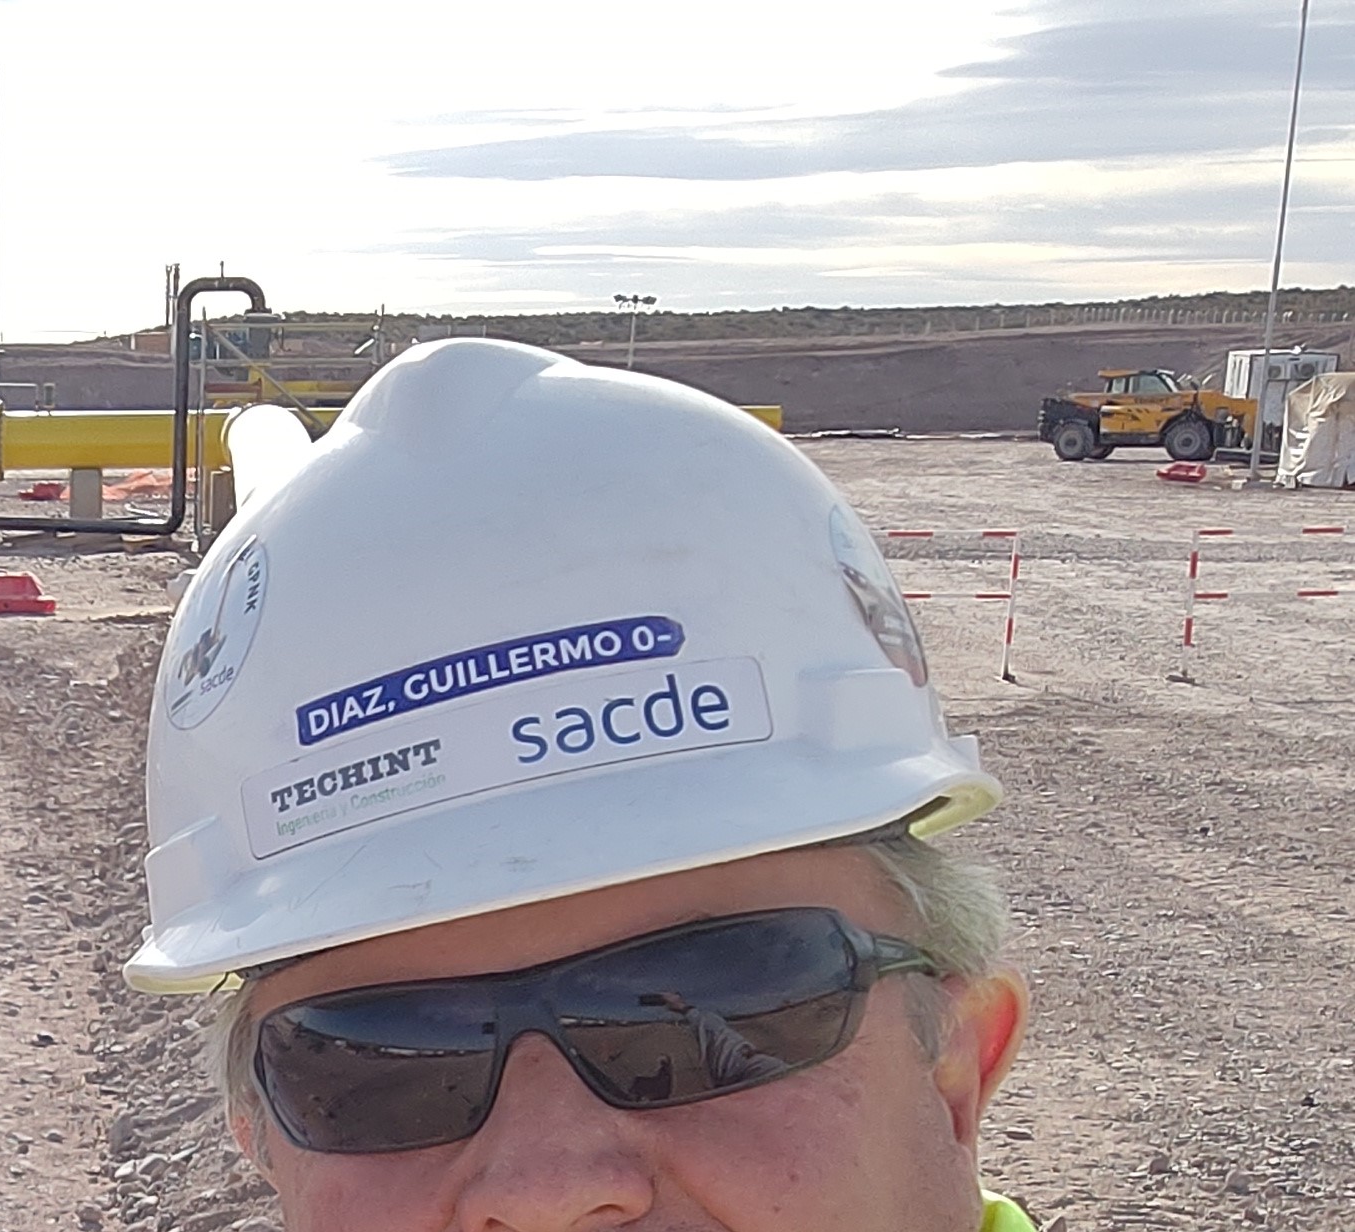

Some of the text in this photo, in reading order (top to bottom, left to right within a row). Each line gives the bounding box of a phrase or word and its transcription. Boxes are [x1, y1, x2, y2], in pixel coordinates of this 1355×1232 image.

[199, 664, 235, 696] sacde
[308, 685, 396, 738] DIAZ,
[403, 629, 623, 702] GUILLERMO
[270, 673, 731, 813] TECHINT sacde
[276, 805, 338, 837] Ingenera
[350, 771, 447, 811] Construcción
